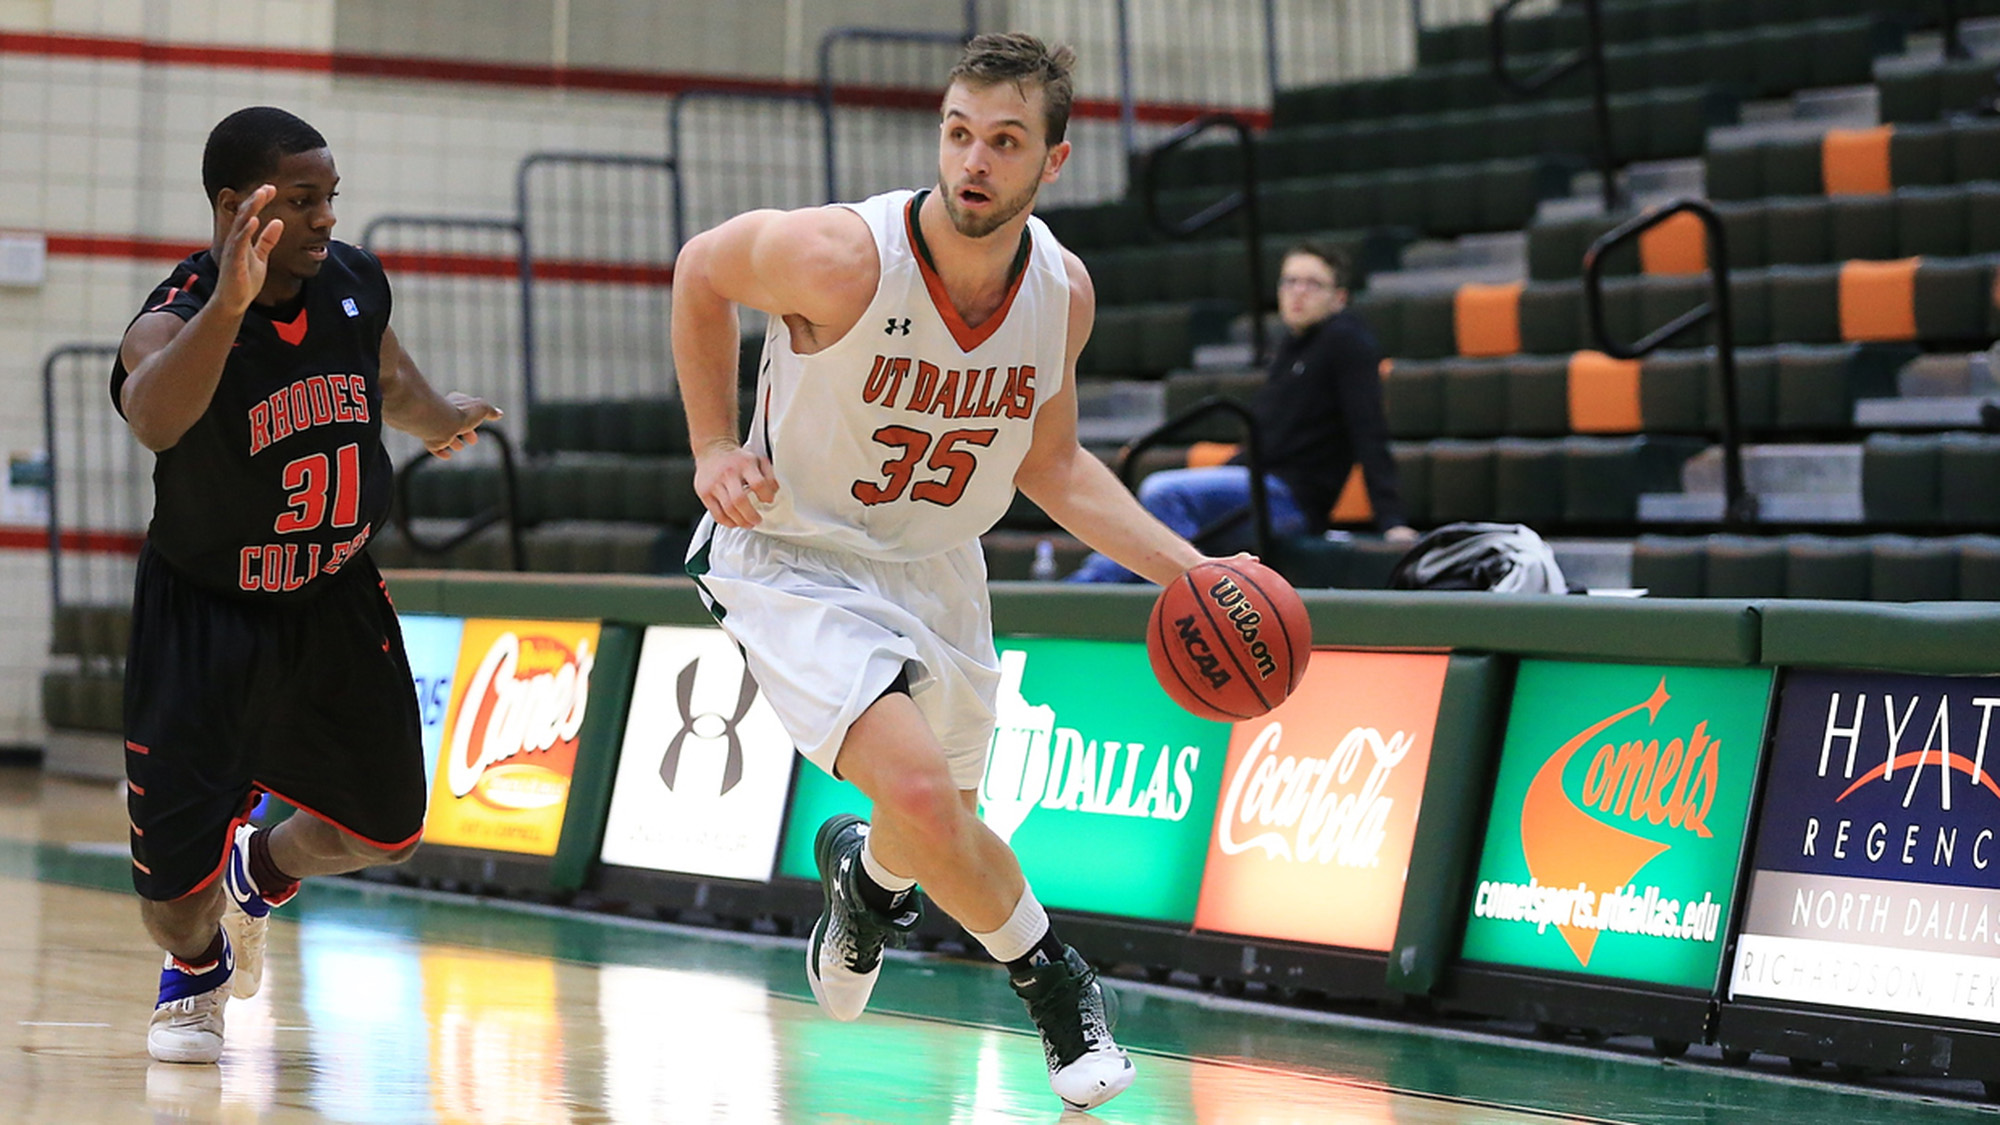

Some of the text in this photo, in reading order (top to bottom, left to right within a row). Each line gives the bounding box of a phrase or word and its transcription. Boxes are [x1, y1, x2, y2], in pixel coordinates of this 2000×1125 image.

[248, 374, 370, 457] RHODES
[862, 354, 1036, 420] UT DALLAS
[274, 442, 360, 534] 31
[851, 424, 999, 507] 35
[1175, 614, 1232, 690] NCAA
[1208, 575, 1277, 681] Wilson
[1040, 727, 1200, 822] DALLAS
[1474, 877, 1722, 942] cometsports.utdallas.edu
[1791, 887, 1891, 934] NORTH
